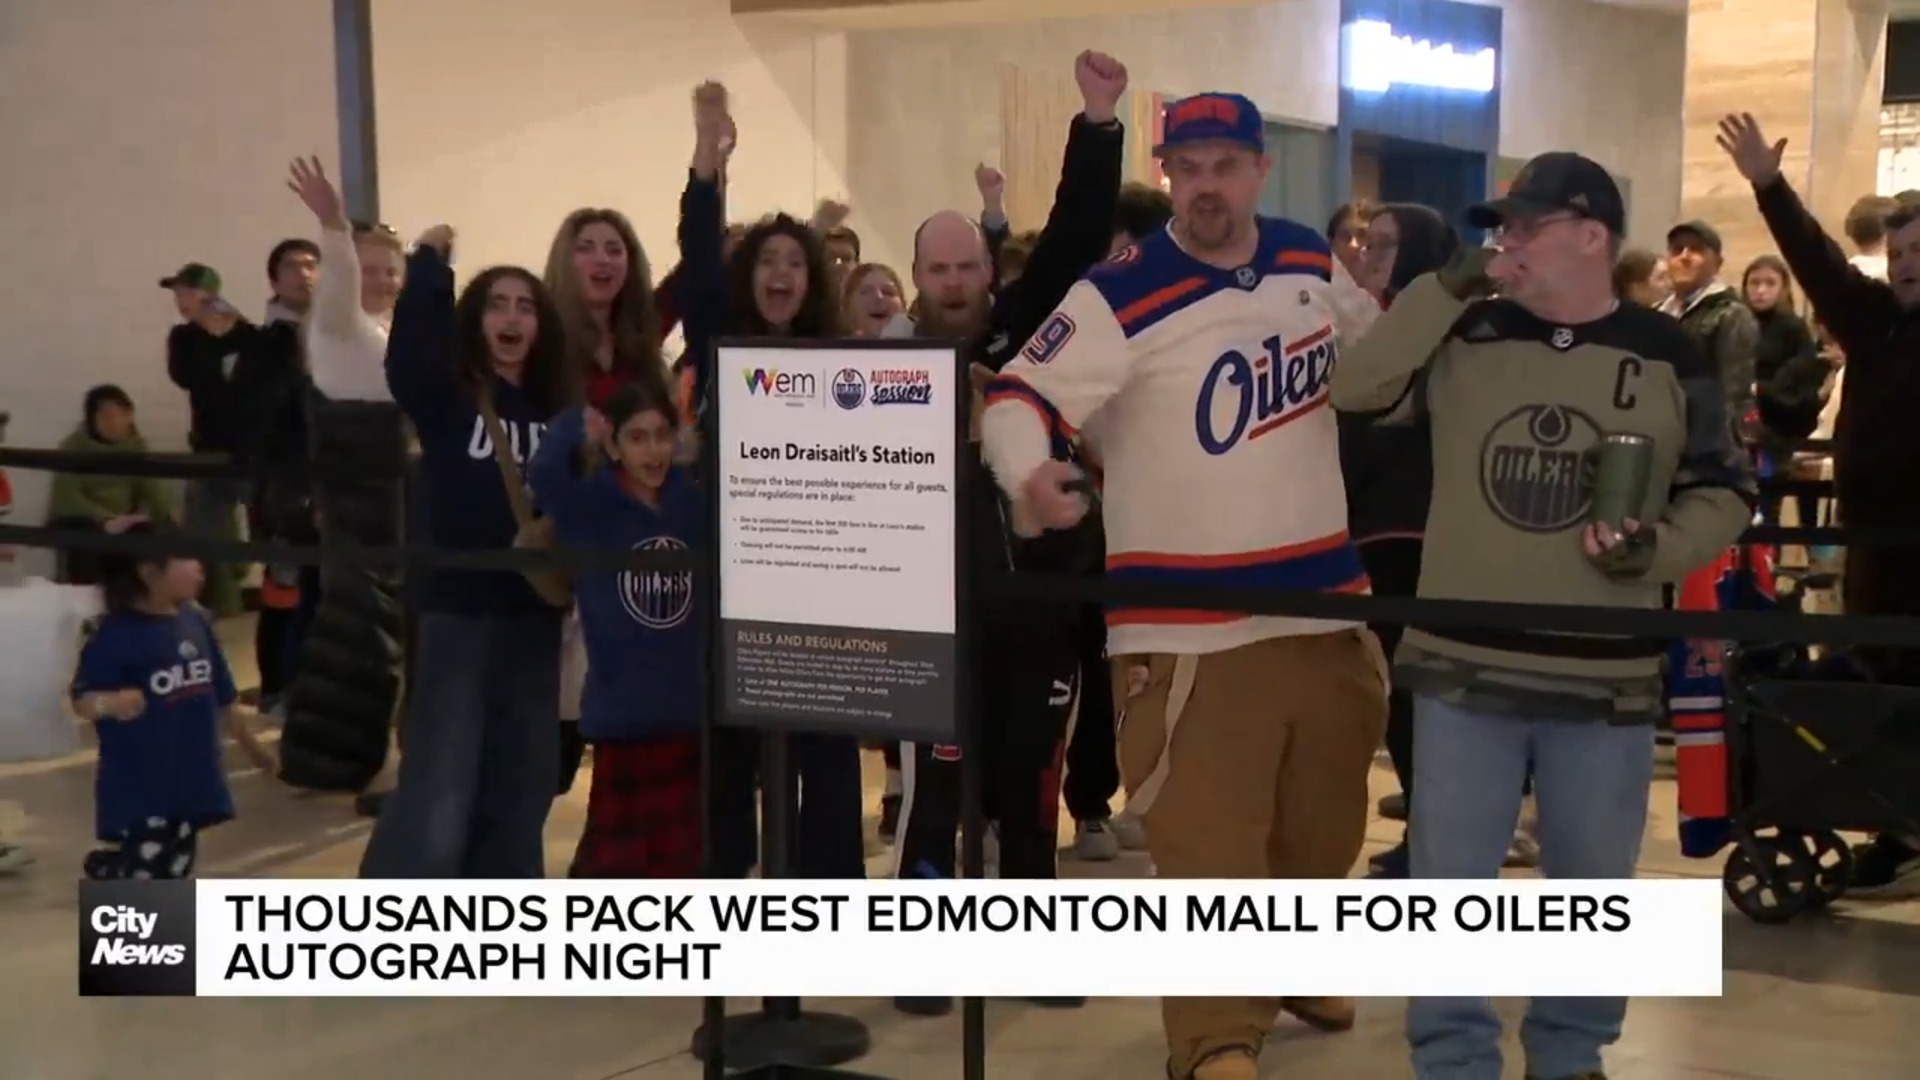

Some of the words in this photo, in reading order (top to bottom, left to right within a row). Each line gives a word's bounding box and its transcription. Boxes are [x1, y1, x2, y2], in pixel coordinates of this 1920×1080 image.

[870, 369, 930, 384] AUTOGRAPH
[1613, 356, 1641, 410] C
[740, 441, 780, 460] Leon
[785, 443, 867, 463] Draisaitl's
[872, 445, 935, 465] Station
[769, 476, 782, 486] the
[785, 477, 803, 487] best
[804, 478, 838, 490] possible
[841, 480, 887, 491] experience
[889, 480, 901, 491] for
[903, 481, 914, 491] all
[729, 489, 756, 500] special
[758, 489, 803, 501] regulations
[805, 492, 818, 500] are
[820, 491, 828, 501] in
[737, 630, 773, 645] RULES
[775, 633, 802, 647] AND
[805, 636, 888, 653] REGULATIONS
